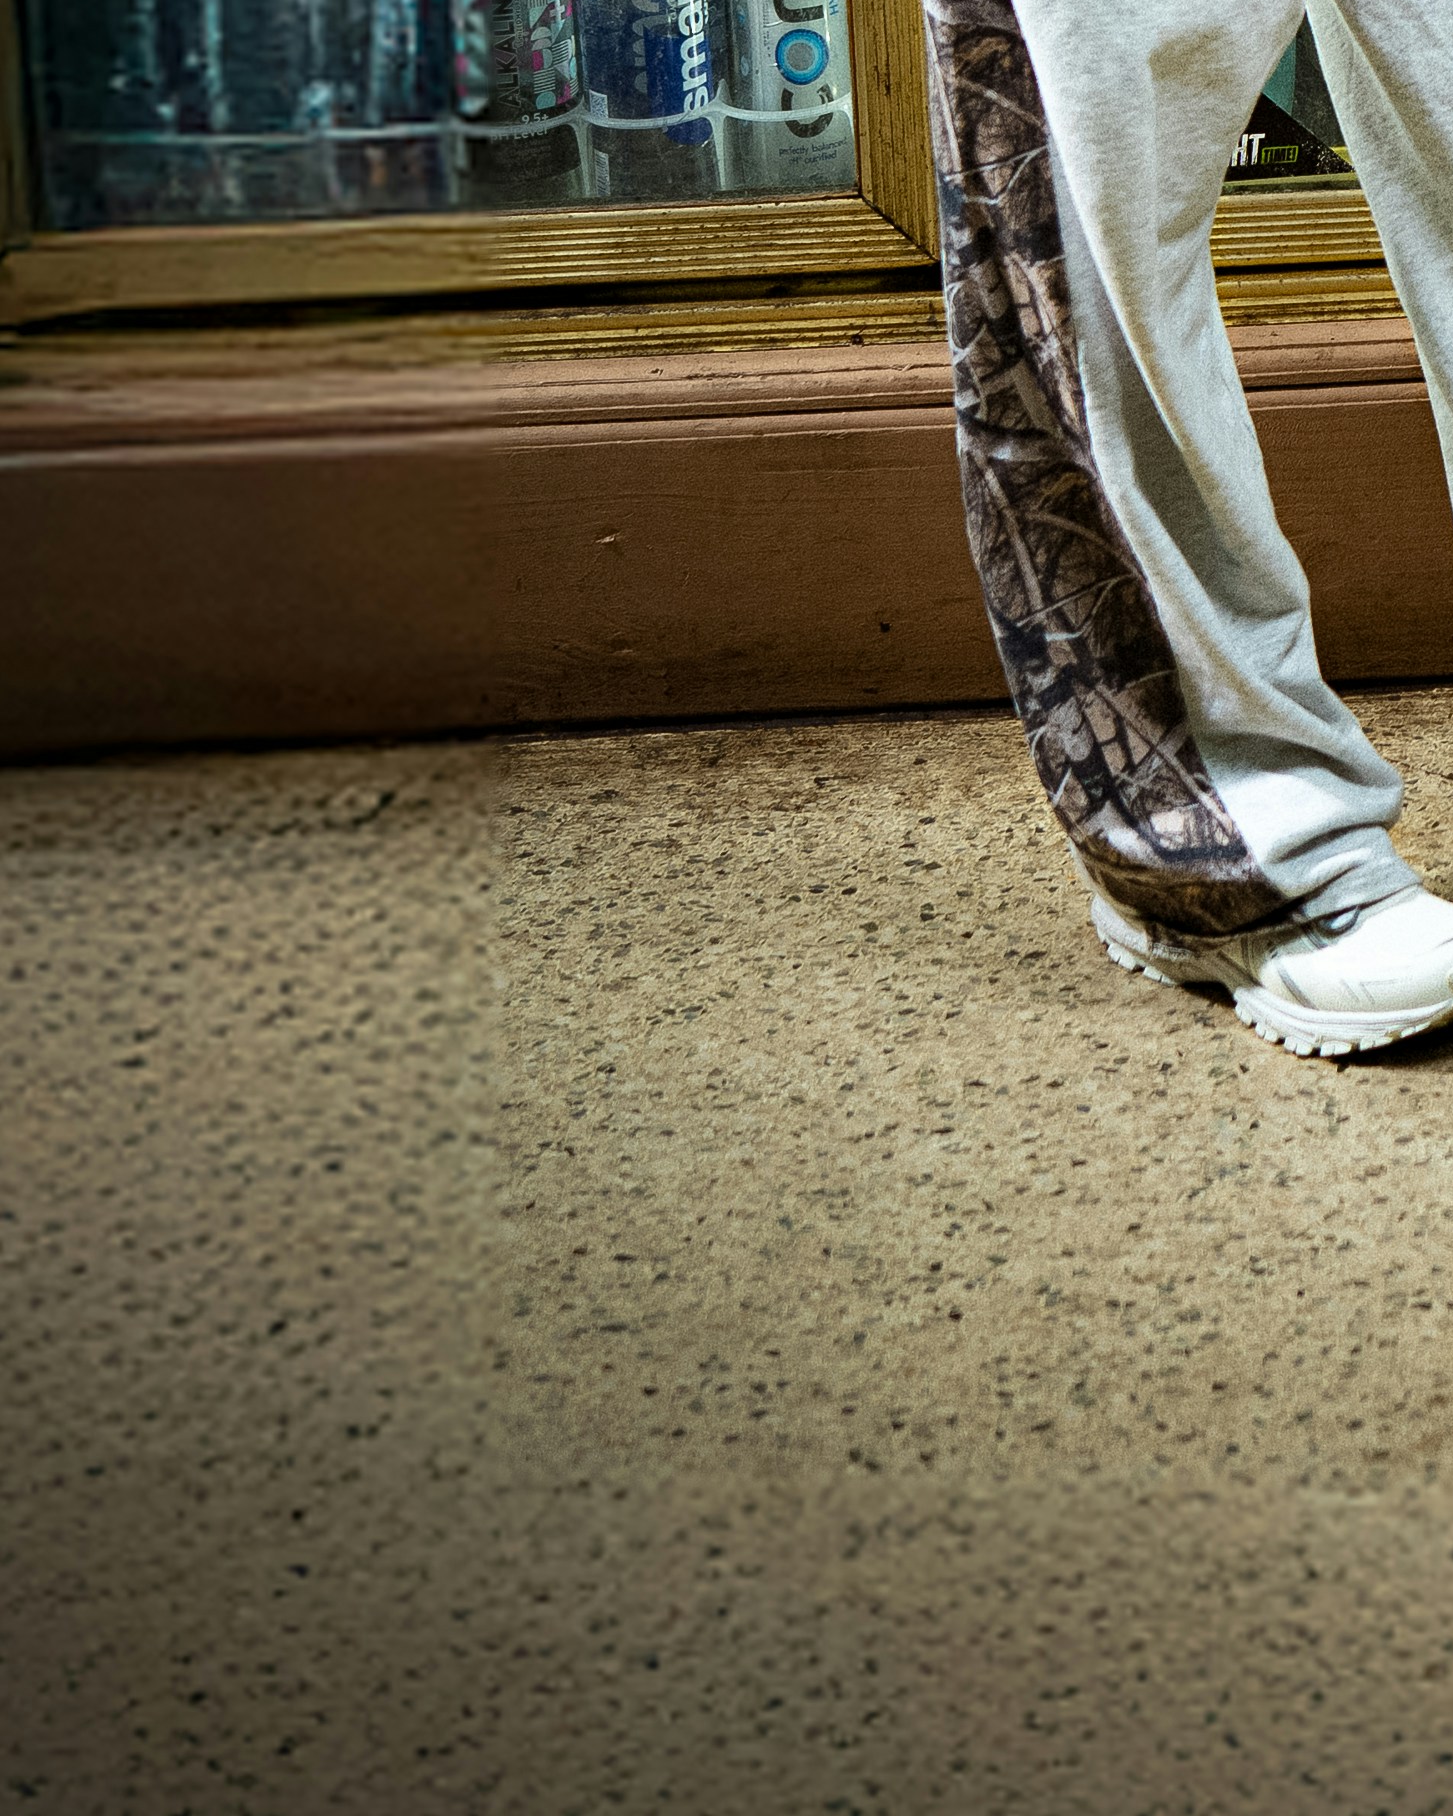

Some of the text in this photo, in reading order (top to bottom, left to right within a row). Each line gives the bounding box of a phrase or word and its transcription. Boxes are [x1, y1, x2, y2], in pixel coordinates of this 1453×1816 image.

[521, 112, 550, 124] 9.5+
[778, 142, 810, 158] perfectly
[1263, 146, 1298, 164] TIME!
